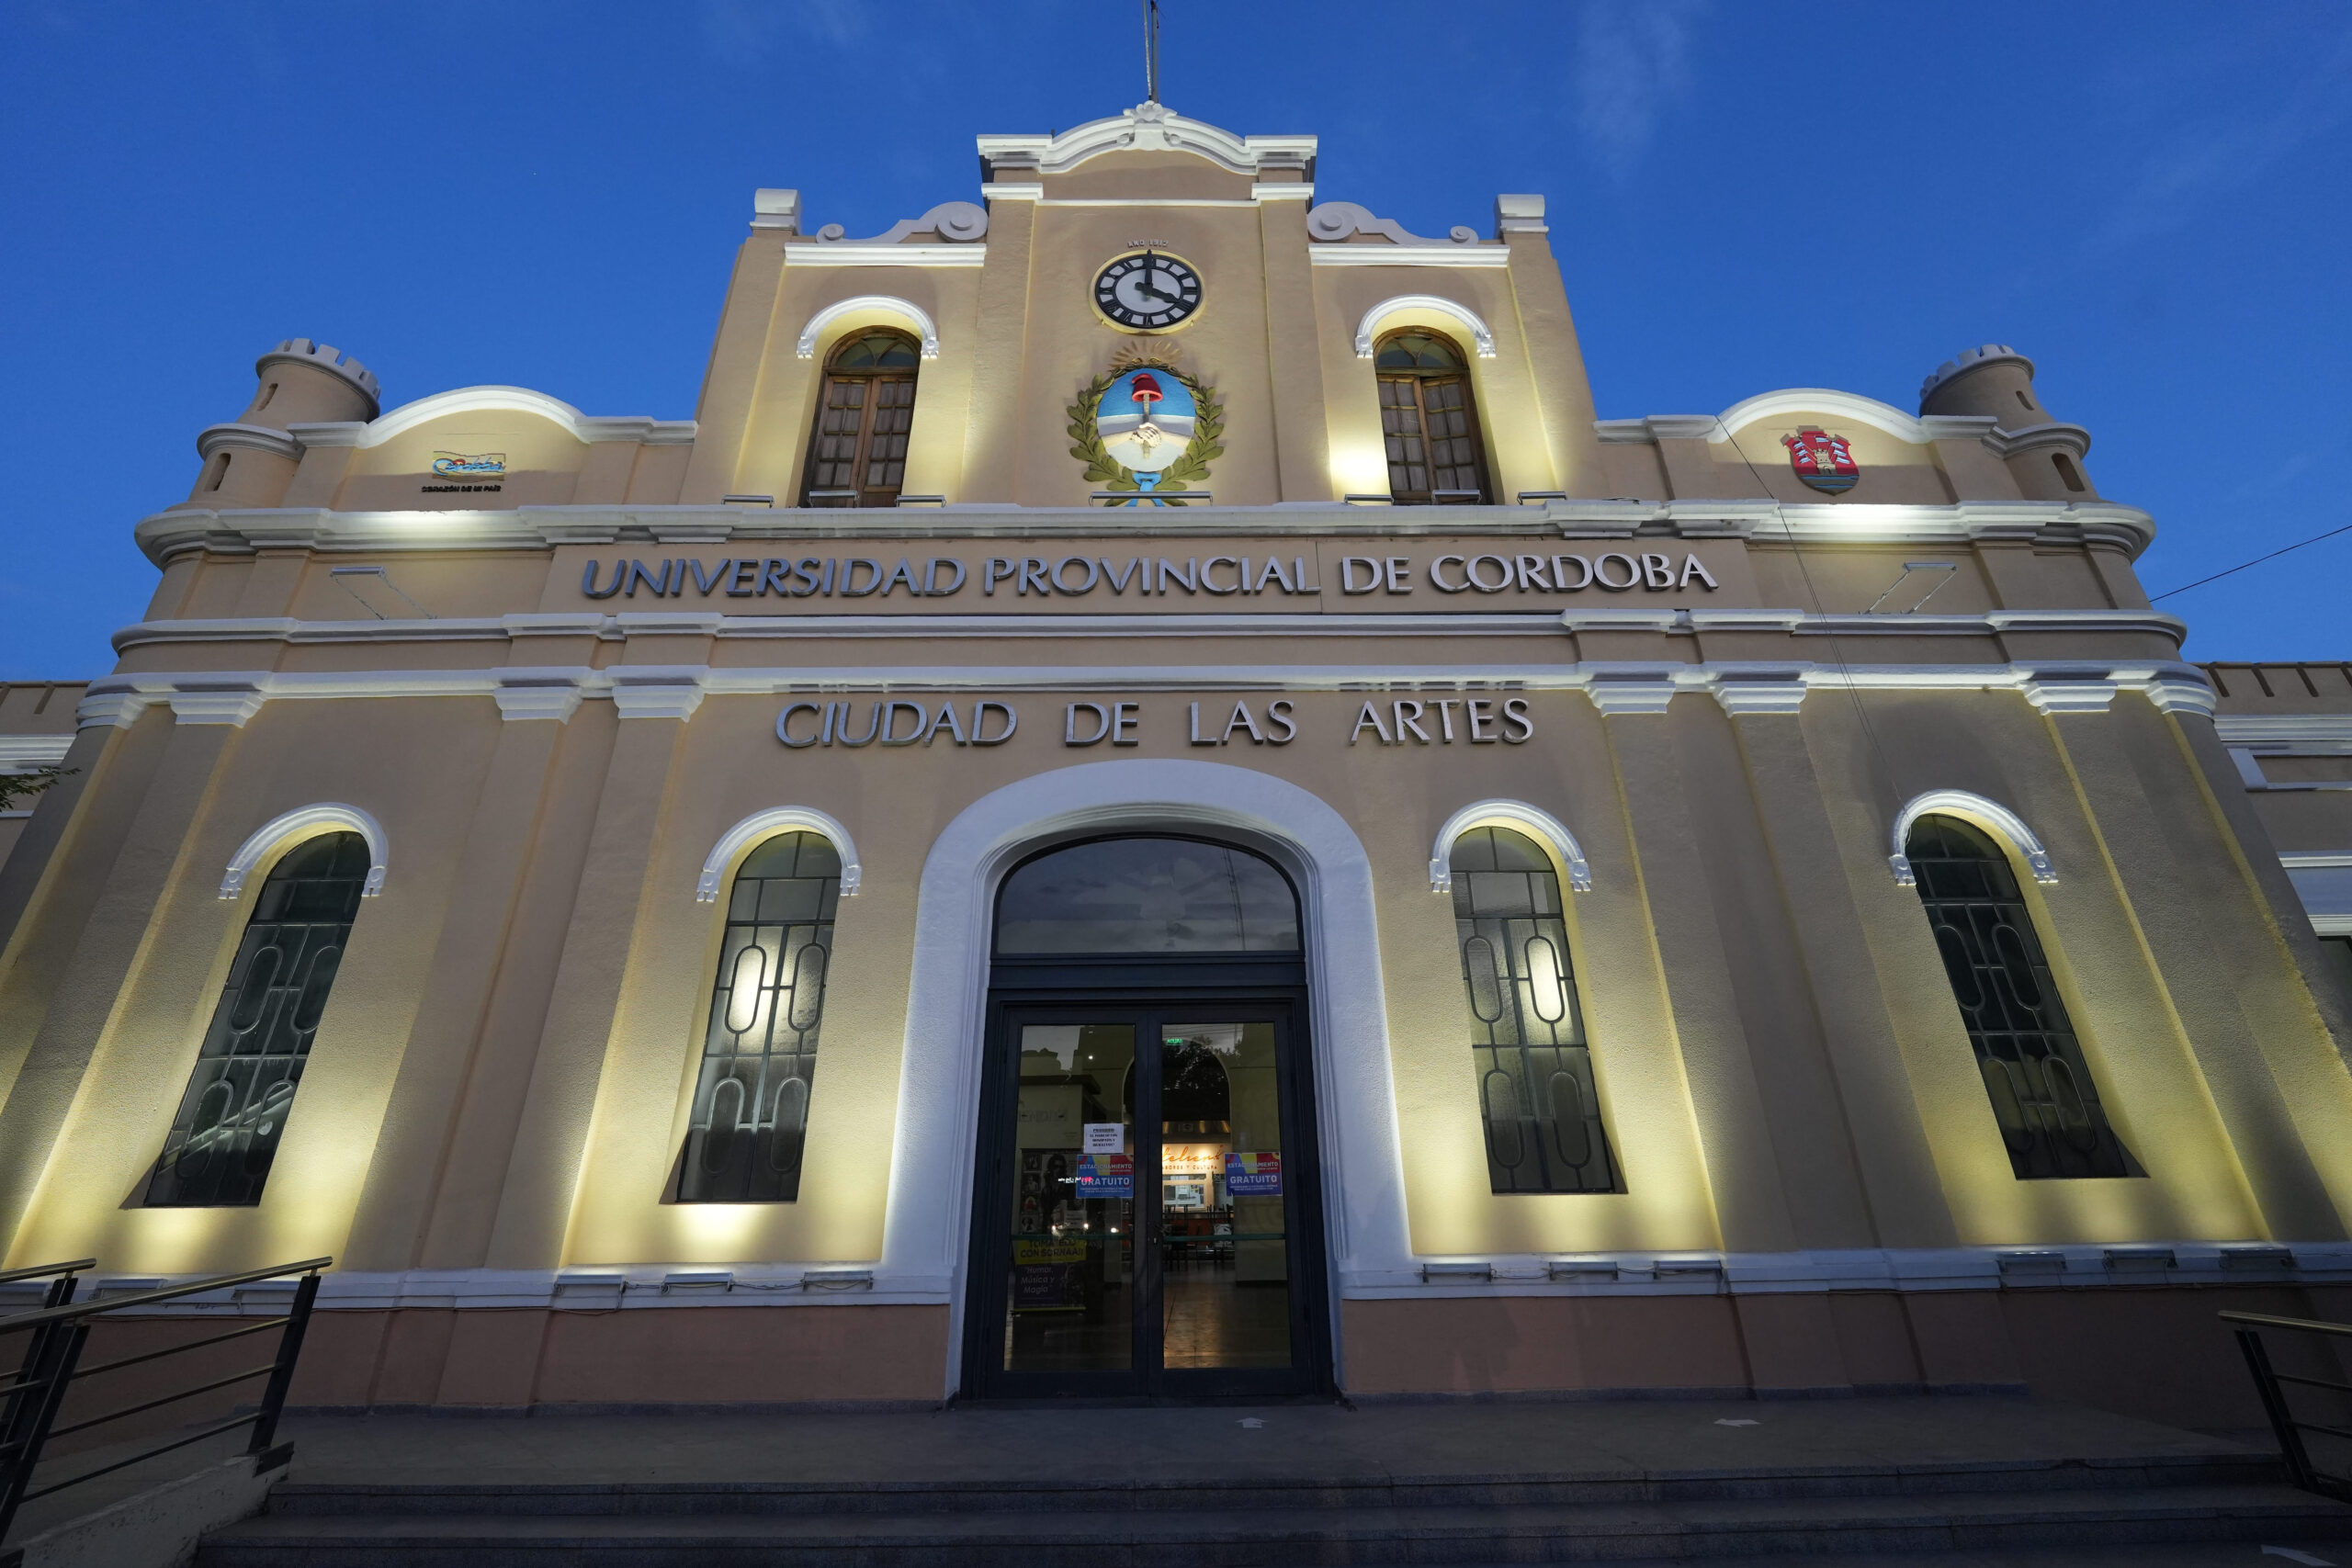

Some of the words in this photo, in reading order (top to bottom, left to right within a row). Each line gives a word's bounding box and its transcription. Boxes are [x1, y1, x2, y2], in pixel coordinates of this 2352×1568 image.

[582, 557, 967, 598] UNIVERSIDAD
[984, 556, 1321, 597] PROVINCIAL
[1341, 555, 1414, 595] DE
[1430, 553, 1719, 592] CORDOBA
[775, 701, 1018, 748] CIUDAD
[1065, 702, 1138, 747] DE
[1190, 699, 1296, 746] LAS
[1350, 698, 1533, 745] ARTES
[1229, 1175, 1277, 1184] GRATUITO
